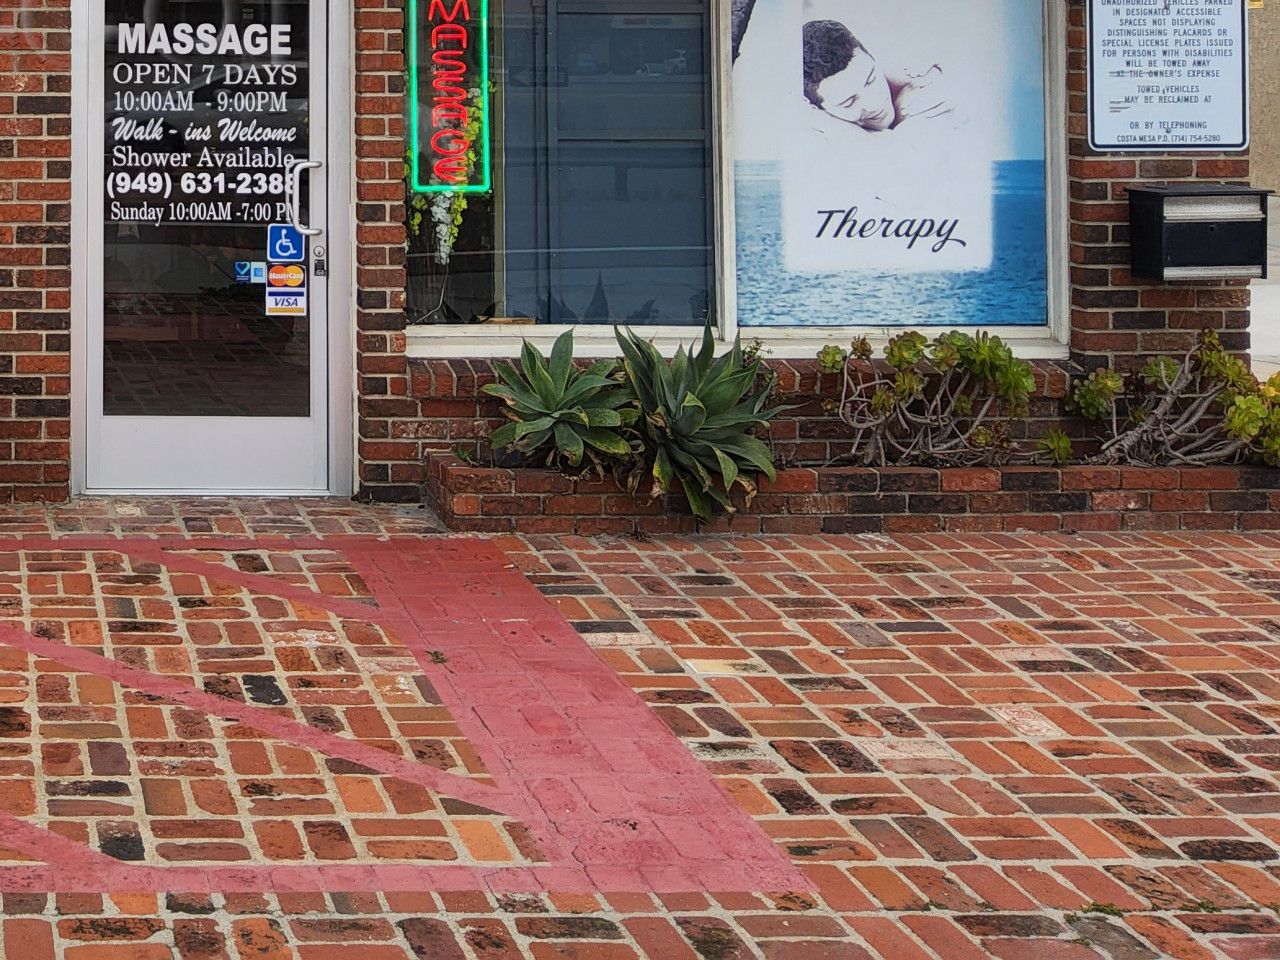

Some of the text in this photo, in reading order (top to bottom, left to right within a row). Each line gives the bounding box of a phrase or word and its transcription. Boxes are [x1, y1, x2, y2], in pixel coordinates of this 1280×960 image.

[1112, 8, 1222, 16] IN DESIGNATED ACCESSIBLE
[1119, 18, 1216, 27] SPACES NOT DISPLAYING
[1107, 28, 1228, 37] DISTINGUISHING PLACARDS OR
[117, 22, 292, 56] MASSAGE
[1102, 39, 1234, 47] SPECIAL LICENSE PLATES ISSUED
[1102, 49, 1233, 58] FOR PERSONS WITH DISABILITIES
[1125, 59, 1211, 68] WILL BE TOWED AWAY
[112, 62, 297, 86] OPEN 7 DAYS
[1129, 70, 1144, 78] THE
[1148, 70, 1182, 78] OWNER'S
[1187, 70, 1221, 78] EXPENSE
[1137, 85, 1200, 94] TOWED VEHICLES
[114, 90, 195, 112] 10:00AM
[217, 91, 288, 112] 9:00PM
[1124, 96, 1212, 104] MAY BE RECLAIMED AT
[112, 117, 164, 142] Walk
[184, 121, 212, 141] ins
[217, 117, 297, 143] Welcome
[1129, 121, 1208, 130] OR BY TELEPHONING
[1116, 134, 1137, 143] COSTA
[1138, 134, 1156, 143] MESA
[112, 145, 295, 169] Shower Available
[106, 172, 172, 199] (949)
[110, 201, 164, 227] Sunday
[169, 202, 232, 221] 10:00AM
[815, 206, 967, 253] Therapy
[274, 297, 298, 307] VISA
